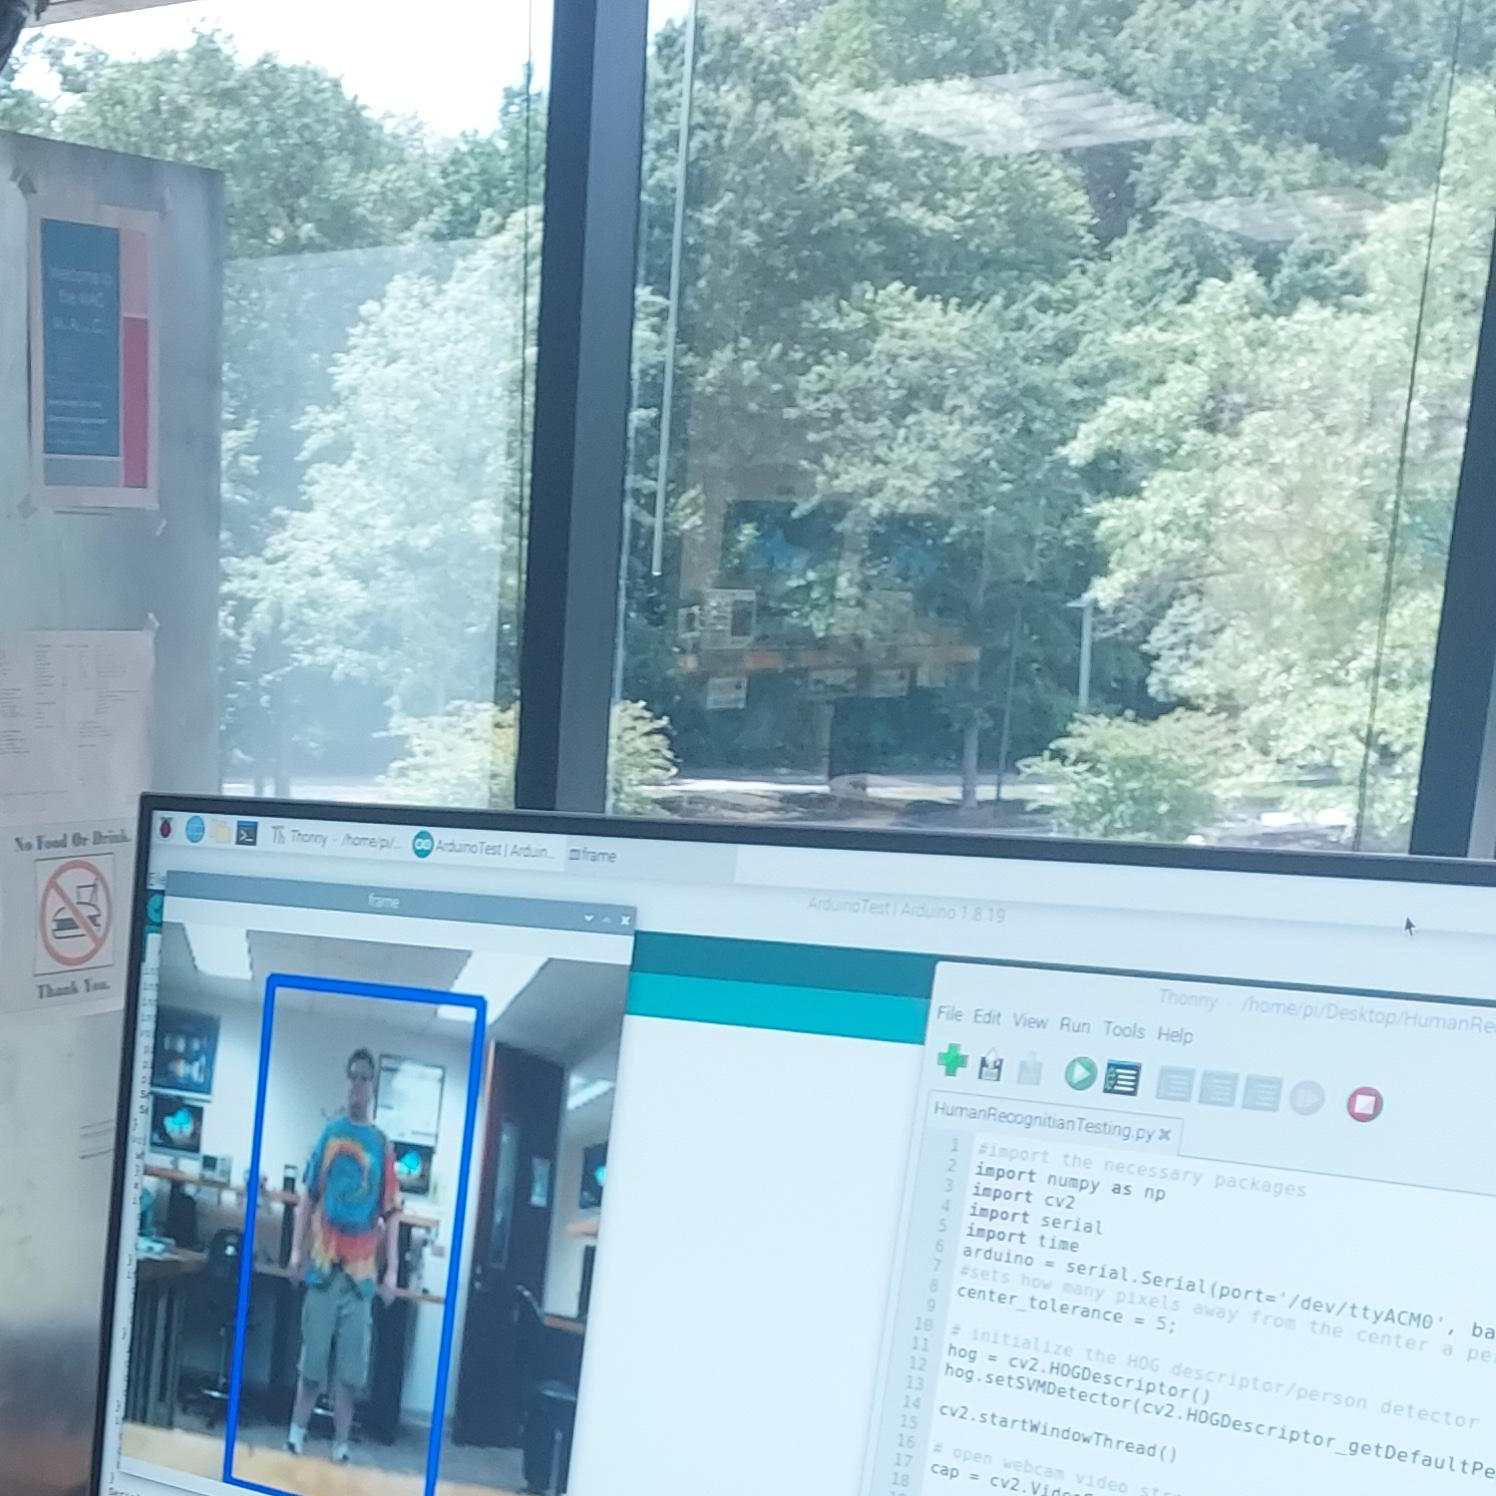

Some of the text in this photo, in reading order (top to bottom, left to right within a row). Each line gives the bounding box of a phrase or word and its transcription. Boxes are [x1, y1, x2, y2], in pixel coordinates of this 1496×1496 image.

[15, 829, 131, 852] No Food Or Drink.
[291, 829, 327, 847] Thonny
[434, 840, 505, 857] ArduinoTest
[582, 848, 617, 864] frame
[807, 896, 891, 915] ArduinoTest
[899, 901, 956, 920] Arduino
[38, 983, 79, 999] Thank
[1159, 990, 1218, 1012] Thonny
[937, 1005, 1193, 1046] File Edit View Run Tools Help
[976, 1161, 1165, 1202] import numpy as np
[1064, 1152, 1092, 1169] the
[1104, 1161, 1202, 1186] necessary
[1214, 1175, 1306, 1197] packages
[973, 1184, 1075, 1209] import cv2
[970, 1202, 1101, 1235] import serial
[966, 1222, 1079, 1252] import time
[963, 1246, 1033, 1266] arduino
[958, 1287, 1175, 1334] center_tolerance 5;
[1021, 1271, 1052, 1289] how
[1062, 1283, 1104, 1302] many
[1116, 1291, 1180, 1311] pixels
[1193, 1304, 1238, 1323] away
[1253, 1309, 1296, 1330] from
[1311, 1318, 1343, 1337] the
[1357, 1330, 1428, 1350] center
[1442, 1344, 1453, 1356] a
[1467, 1348, 1496, 1363] pe
[948, 1342, 1208, 1404] hog cv2.HOGDescriptor()
[972, 1327, 1480, 1428] initialize the HOG descriptor/person detector
[940, 1405, 1175, 1462] cv2.startWindowThread()
[931, 1464, 959, 1479] cap
[953, 1449, 991, 1464] open
[1003, 1459, 1064, 1480] webcam
[1076, 1474, 1128, 1493] video
